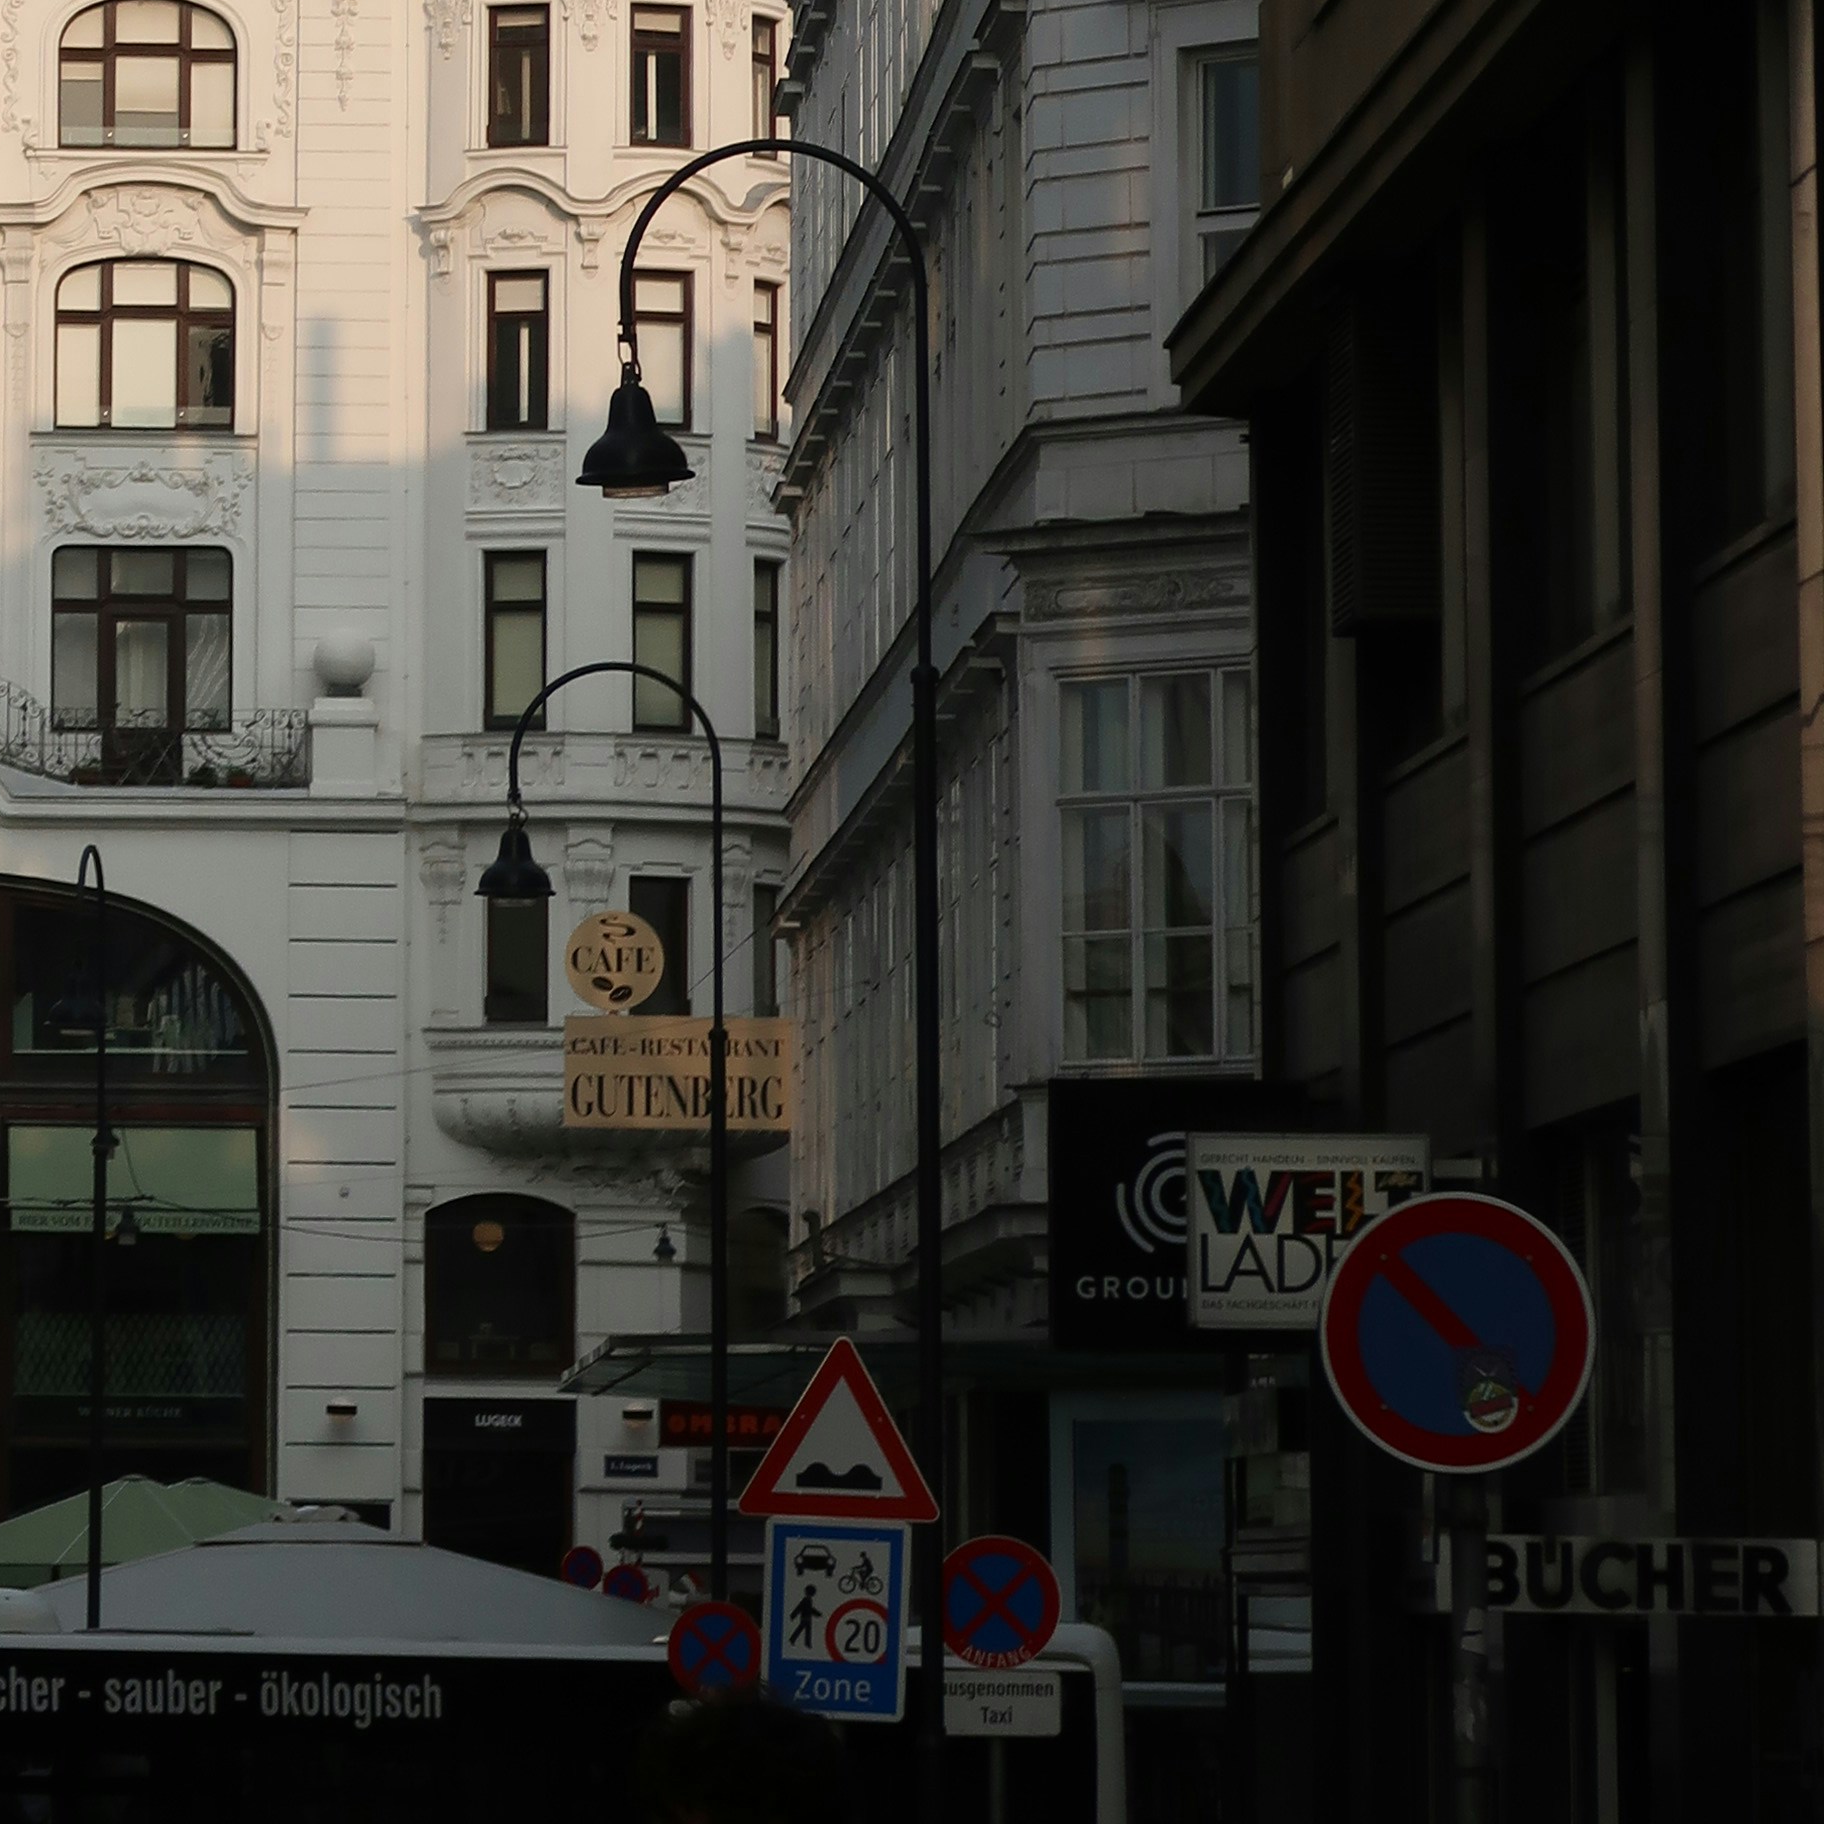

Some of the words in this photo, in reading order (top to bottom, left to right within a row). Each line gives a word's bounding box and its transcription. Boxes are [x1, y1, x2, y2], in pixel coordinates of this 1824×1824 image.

[570, 944, 656, 974] CAFE
[568, 1037, 785, 1058] CAFE-RESTARANT
[1200, 1153, 1248, 1164] GERECHT
[1252, 1153, 1306, 1164] HANDELN
[1373, 1154, 1417, 1164] KAUFEN
[1197, 1169, 1424, 1239] WELT
[1201, 1233, 1352, 1292] LADE
[1076, 1275, 1188, 1300] GROU
[1201, 1299, 1224, 1309] DAS
[77, 1407, 133, 1418] WNER
[474, 1414, 523, 1427] LUGECK
[1486, 1534, 1794, 1617] BÜCHER
[844, 1618, 881, 1654] 20
[960, 1643, 1032, 1668] ANFANG
[793, 1669, 873, 1702] Zone
[103, 1668, 223, 1715] sauber
[260, 1670, 444, 1729] ökologisch
[981, 1705, 1014, 1724] Taxi
